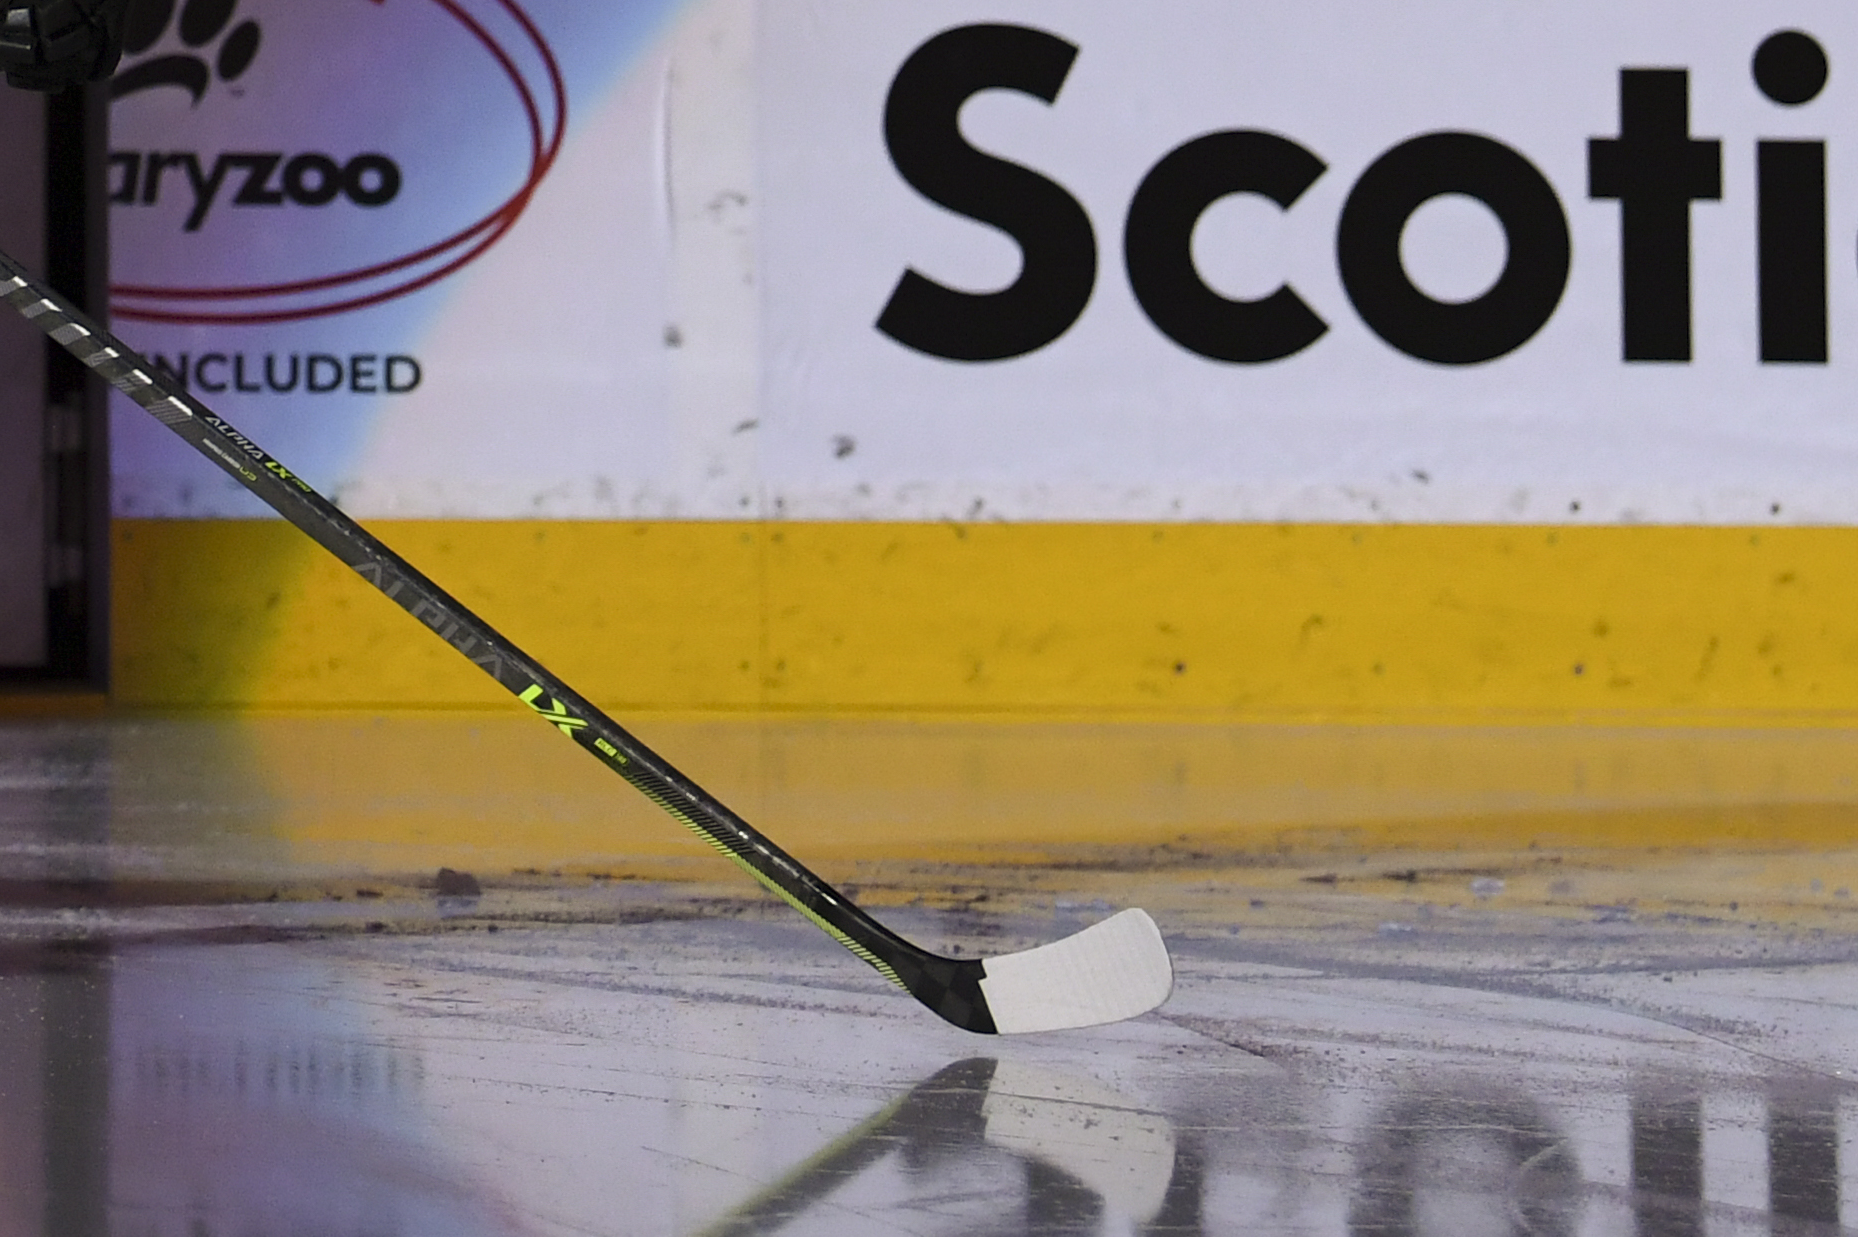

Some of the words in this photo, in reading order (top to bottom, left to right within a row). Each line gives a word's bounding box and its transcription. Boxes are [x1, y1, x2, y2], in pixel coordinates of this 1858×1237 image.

[875, 21, 1858, 365] Scoti
[144, 352, 422, 394] NCLUDED
[204, 416, 264, 460] ALPHA
[264, 461, 293, 480] LX
[519, 684, 589, 739] LX
